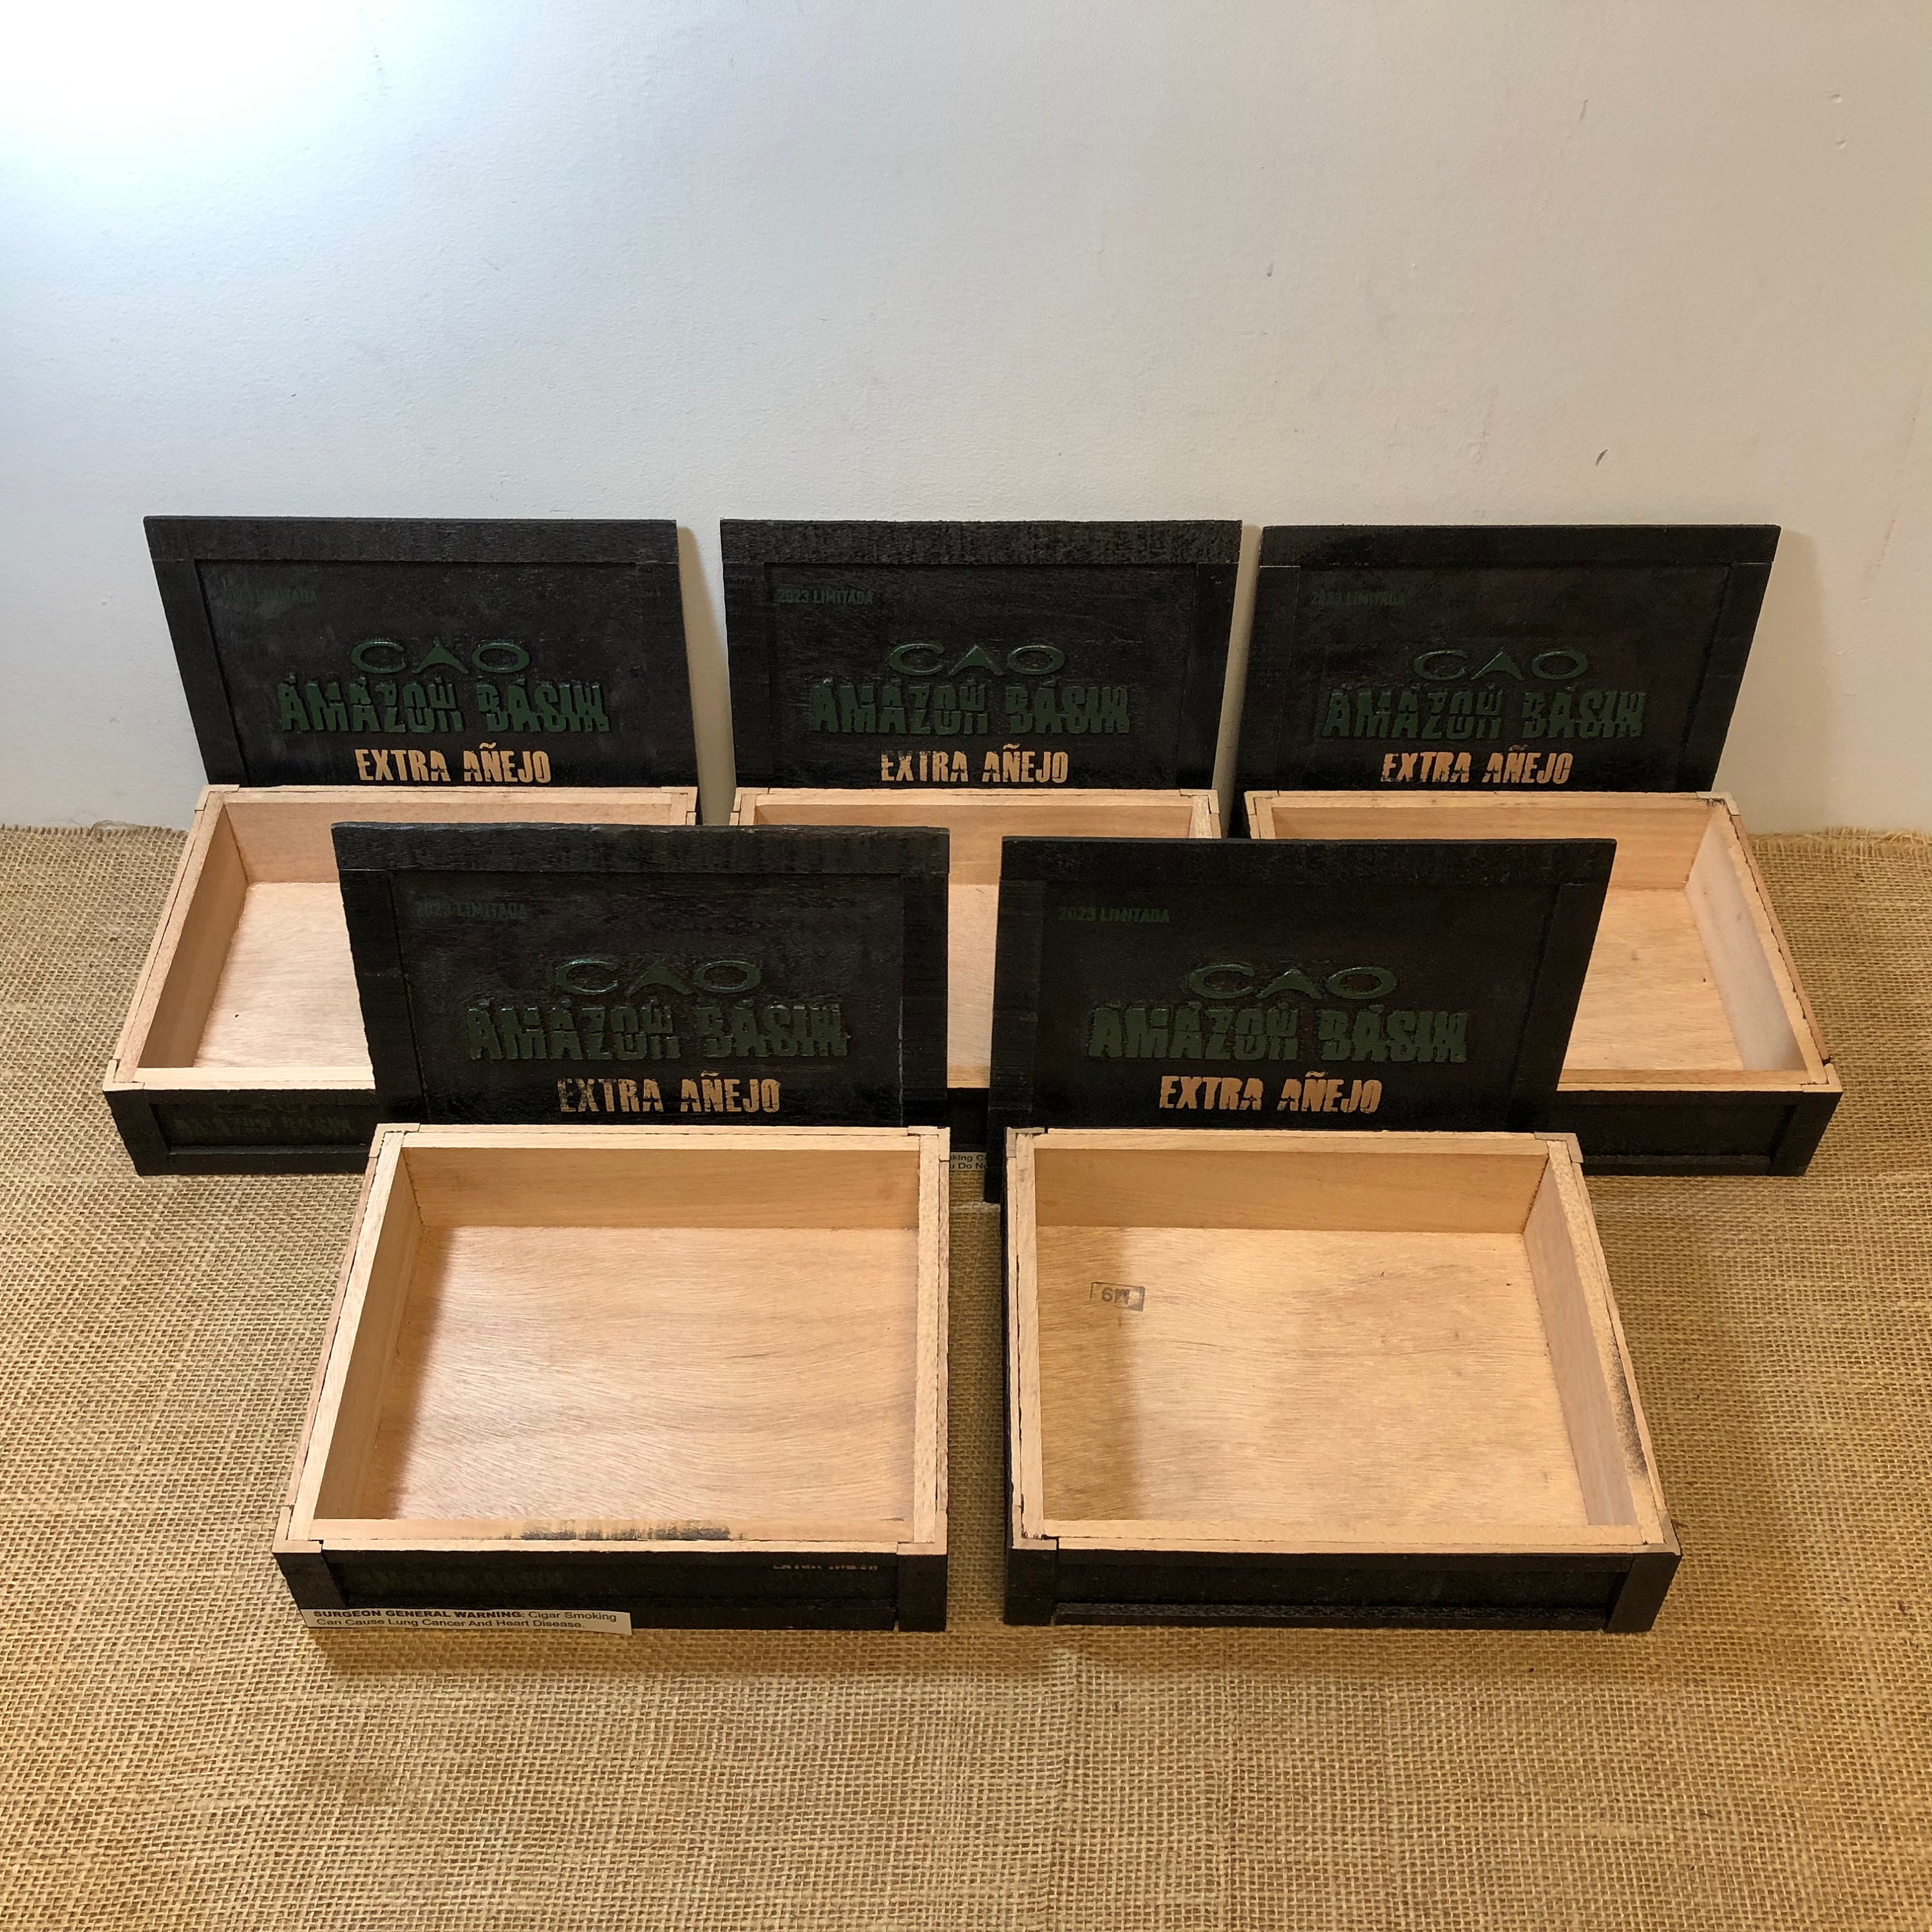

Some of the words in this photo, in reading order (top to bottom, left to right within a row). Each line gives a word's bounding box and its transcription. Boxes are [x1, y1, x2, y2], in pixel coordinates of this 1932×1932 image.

[350, 639, 531, 674] CAO
[888, 642, 1066, 677] CAO
[1413, 649, 1589, 681] CAO
[354, 748, 451, 782] EXTRA
[462, 742, 552, 784] AÑEJO
[880, 750, 969, 783] EXTRA
[982, 743, 1069, 784] AÑEJO
[1380, 752, 1472, 783] EXTRA
[1482, 744, 1574, 784] AÑEJO
[555, 959, 762, 997] CAO
[1188, 964, 1397, 999] CAO
[556, 1078, 665, 1113] EXTRA
[680, 1070, 781, 1114] AÑEJO
[1159, 1075, 1265, 1111] EXTRA
[1277, 1070, 1383, 1113] AÑEJO
[314, 1610, 382, 1618] SURGEON
[386, 1610, 451, 1618] GENERAL
[453, 1611, 526, 1619] WARNING:
[528, 1611, 561, 1620] Cigar
[564, 1612, 618, 1623] Smoking
[388, 1618, 419, 1627] Lung
[422, 1618, 466, 1627] Cancer
[533, 1620, 585, 1629] Disease.
